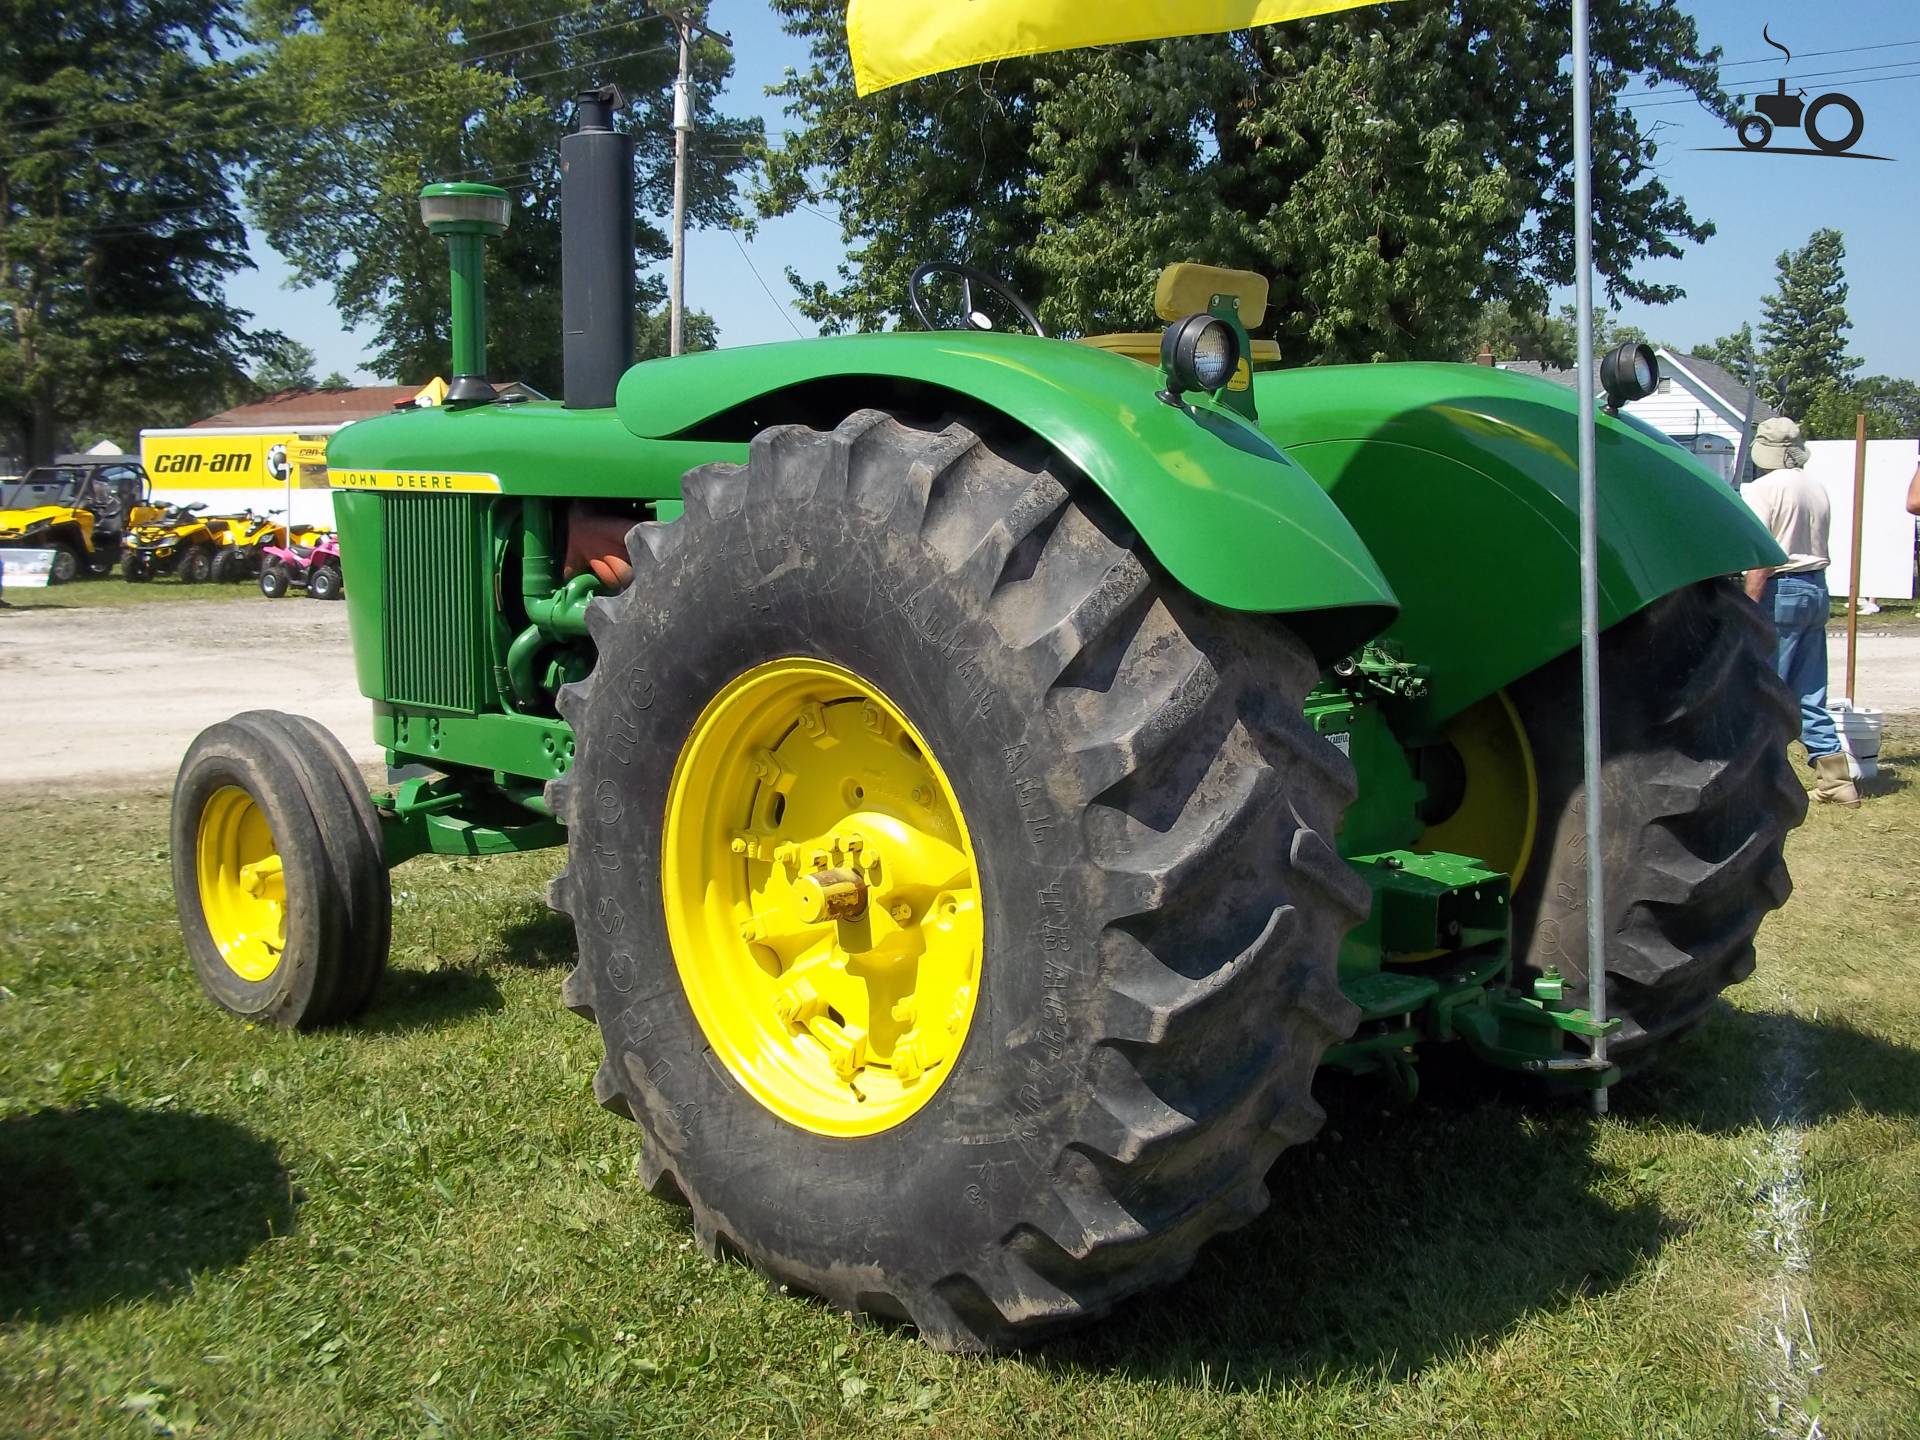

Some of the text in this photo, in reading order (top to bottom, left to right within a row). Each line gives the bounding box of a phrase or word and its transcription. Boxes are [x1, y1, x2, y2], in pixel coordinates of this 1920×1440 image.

[300, 448, 329, 457] can-a
[154, 453, 252, 473] can-am
[341, 473, 453, 489] JOHN DEERE
[1002, 742, 1054, 844] ALL
[1009, 882, 1072, 1143] TRACTION
